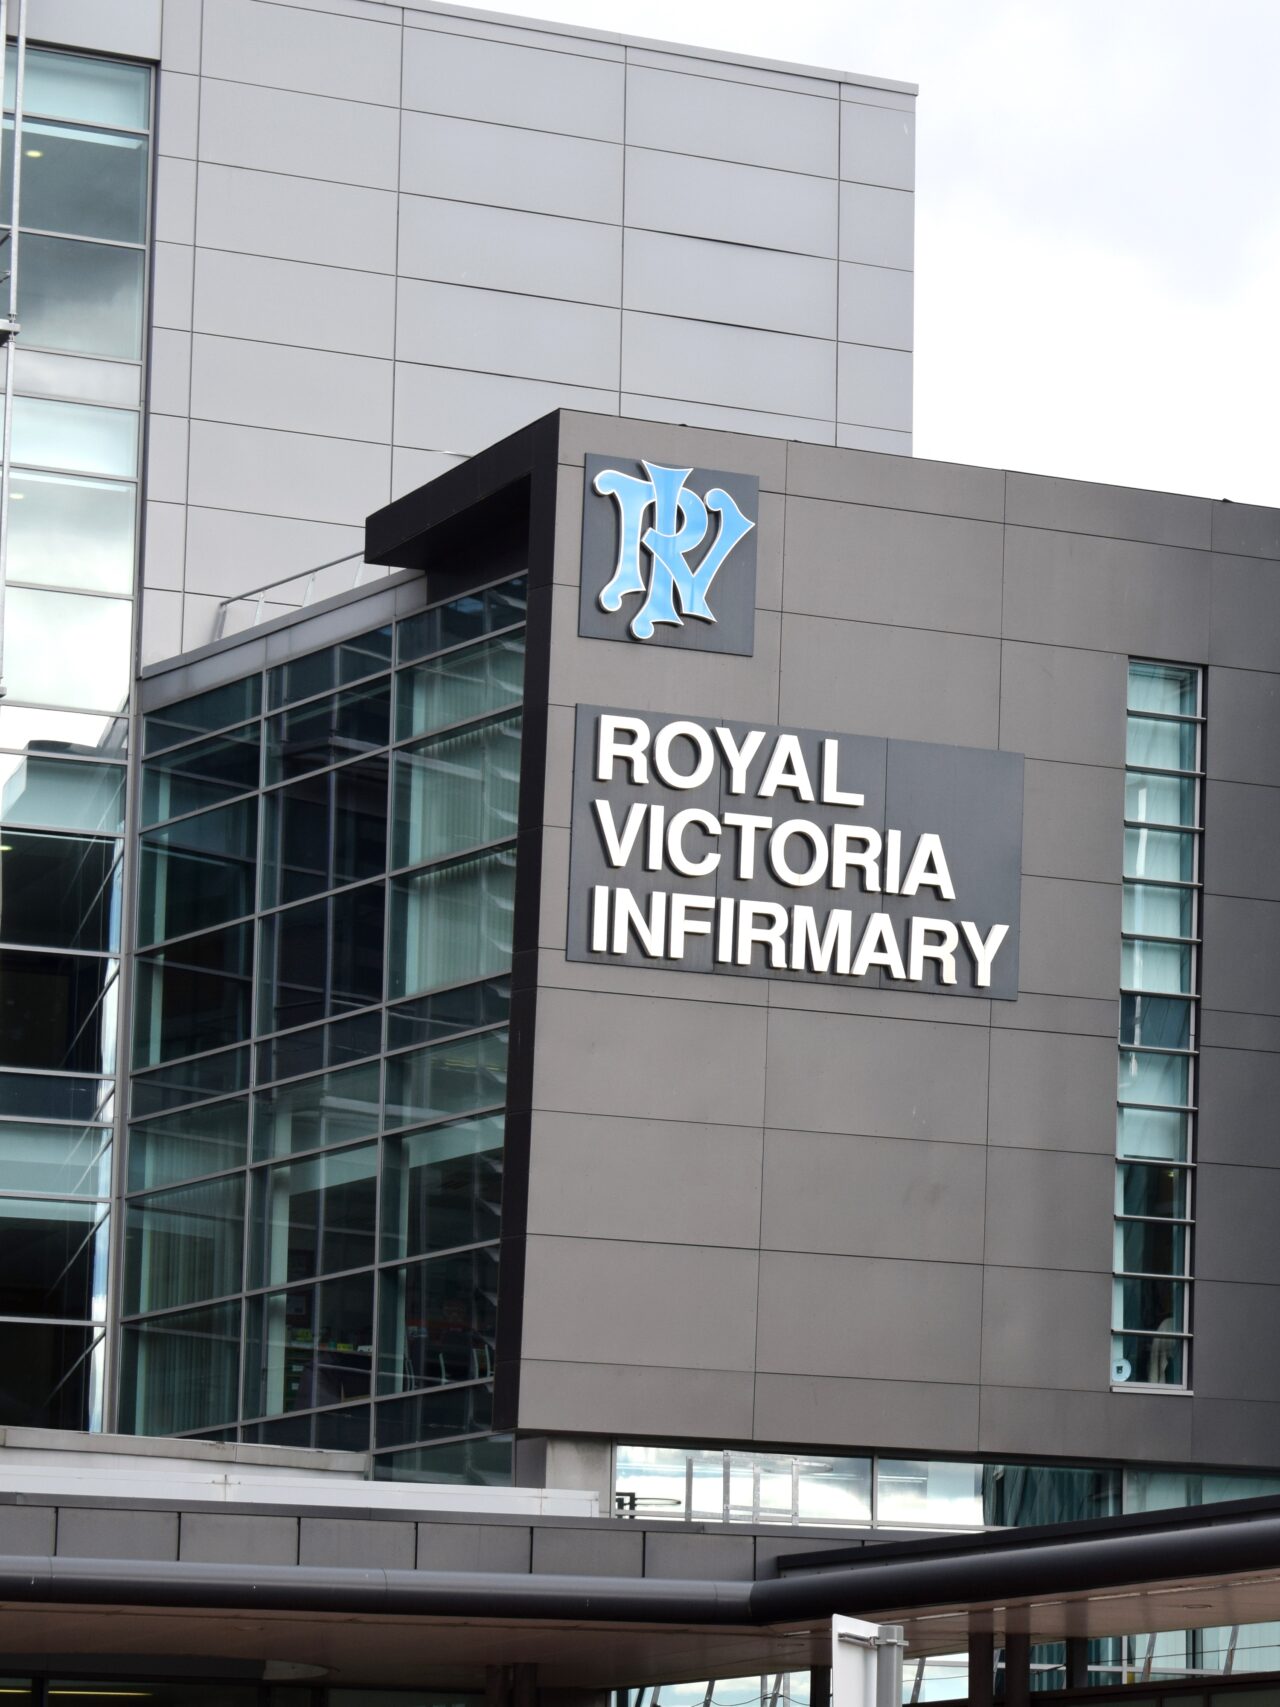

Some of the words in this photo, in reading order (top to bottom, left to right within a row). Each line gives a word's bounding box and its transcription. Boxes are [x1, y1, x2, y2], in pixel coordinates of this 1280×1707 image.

[596, 713, 865, 807] ROYAL
[592, 799, 956, 900] VICTORIA
[590, 885, 1010, 988] INFIRMARY
